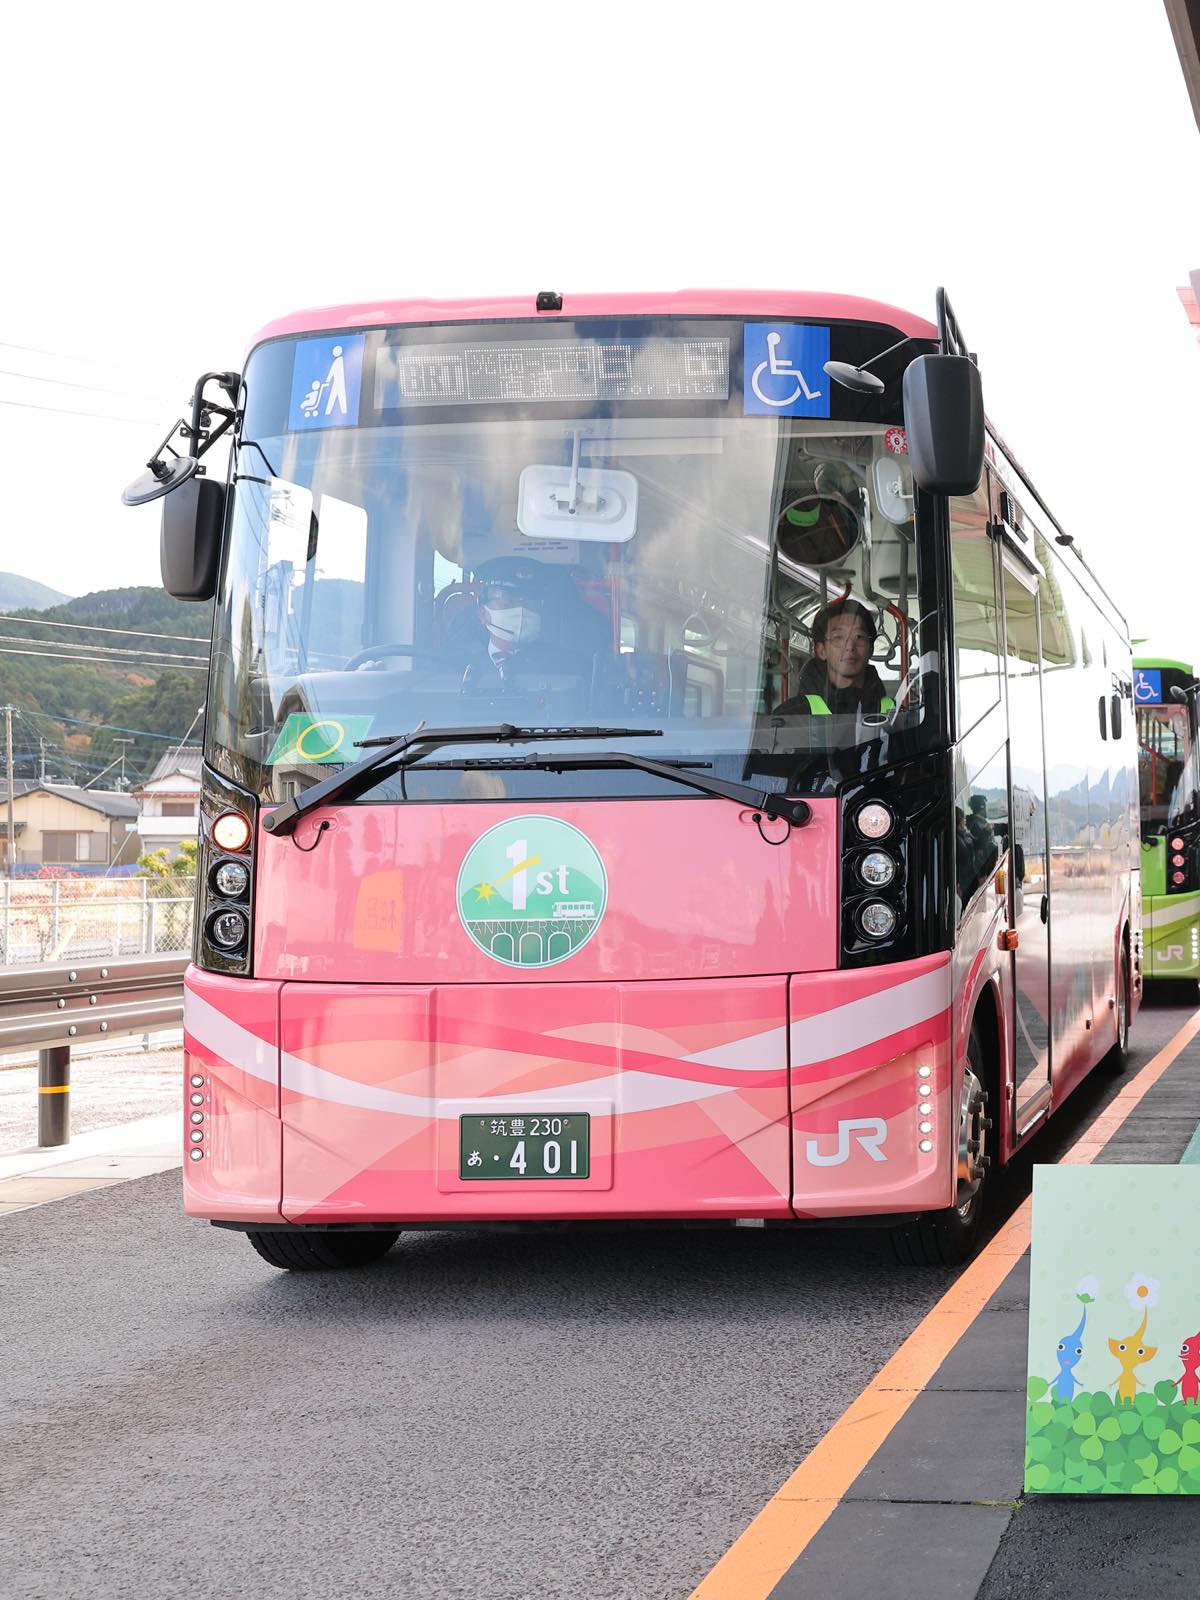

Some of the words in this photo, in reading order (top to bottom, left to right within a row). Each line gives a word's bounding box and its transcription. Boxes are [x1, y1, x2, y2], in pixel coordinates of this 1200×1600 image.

[666, 378, 714, 395] Hita
[506, 839, 569, 911] 1st
[472, 920, 595, 934] ANNIVERSARY
[1157, 944, 1184, 961] JR
[490, 1119, 526, 1136] 筑豊
[530, 1118, 562, 1136] 230
[806, 1117, 889, 1167] JR
[467, 1150, 482, 1167] あ
